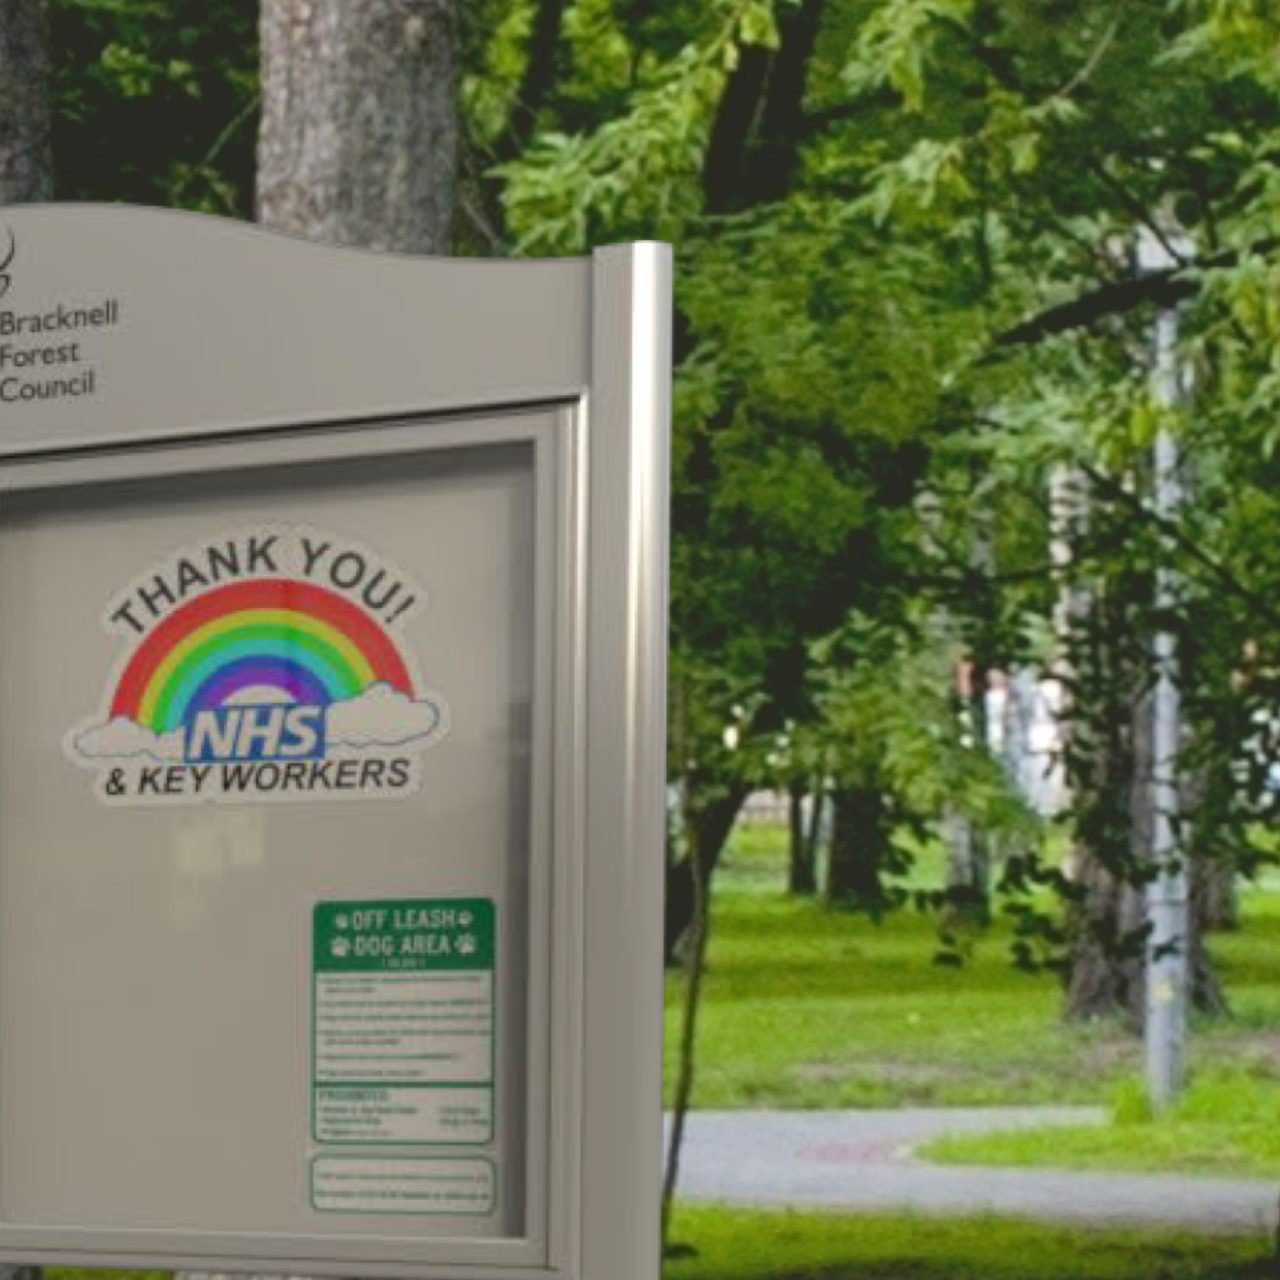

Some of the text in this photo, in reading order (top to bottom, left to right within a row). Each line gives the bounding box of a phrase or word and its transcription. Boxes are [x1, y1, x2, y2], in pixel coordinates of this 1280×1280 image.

[0, 300, 118, 335] Bracknell
[111, 536, 415, 633] THANK YOU!
[190, 706, 320, 758] NHS
[106, 759, 410, 795] & KEY WORKERS
[352, 908, 456, 930] OFF LEASH
[354, 933, 451, 956] DOG AREA
